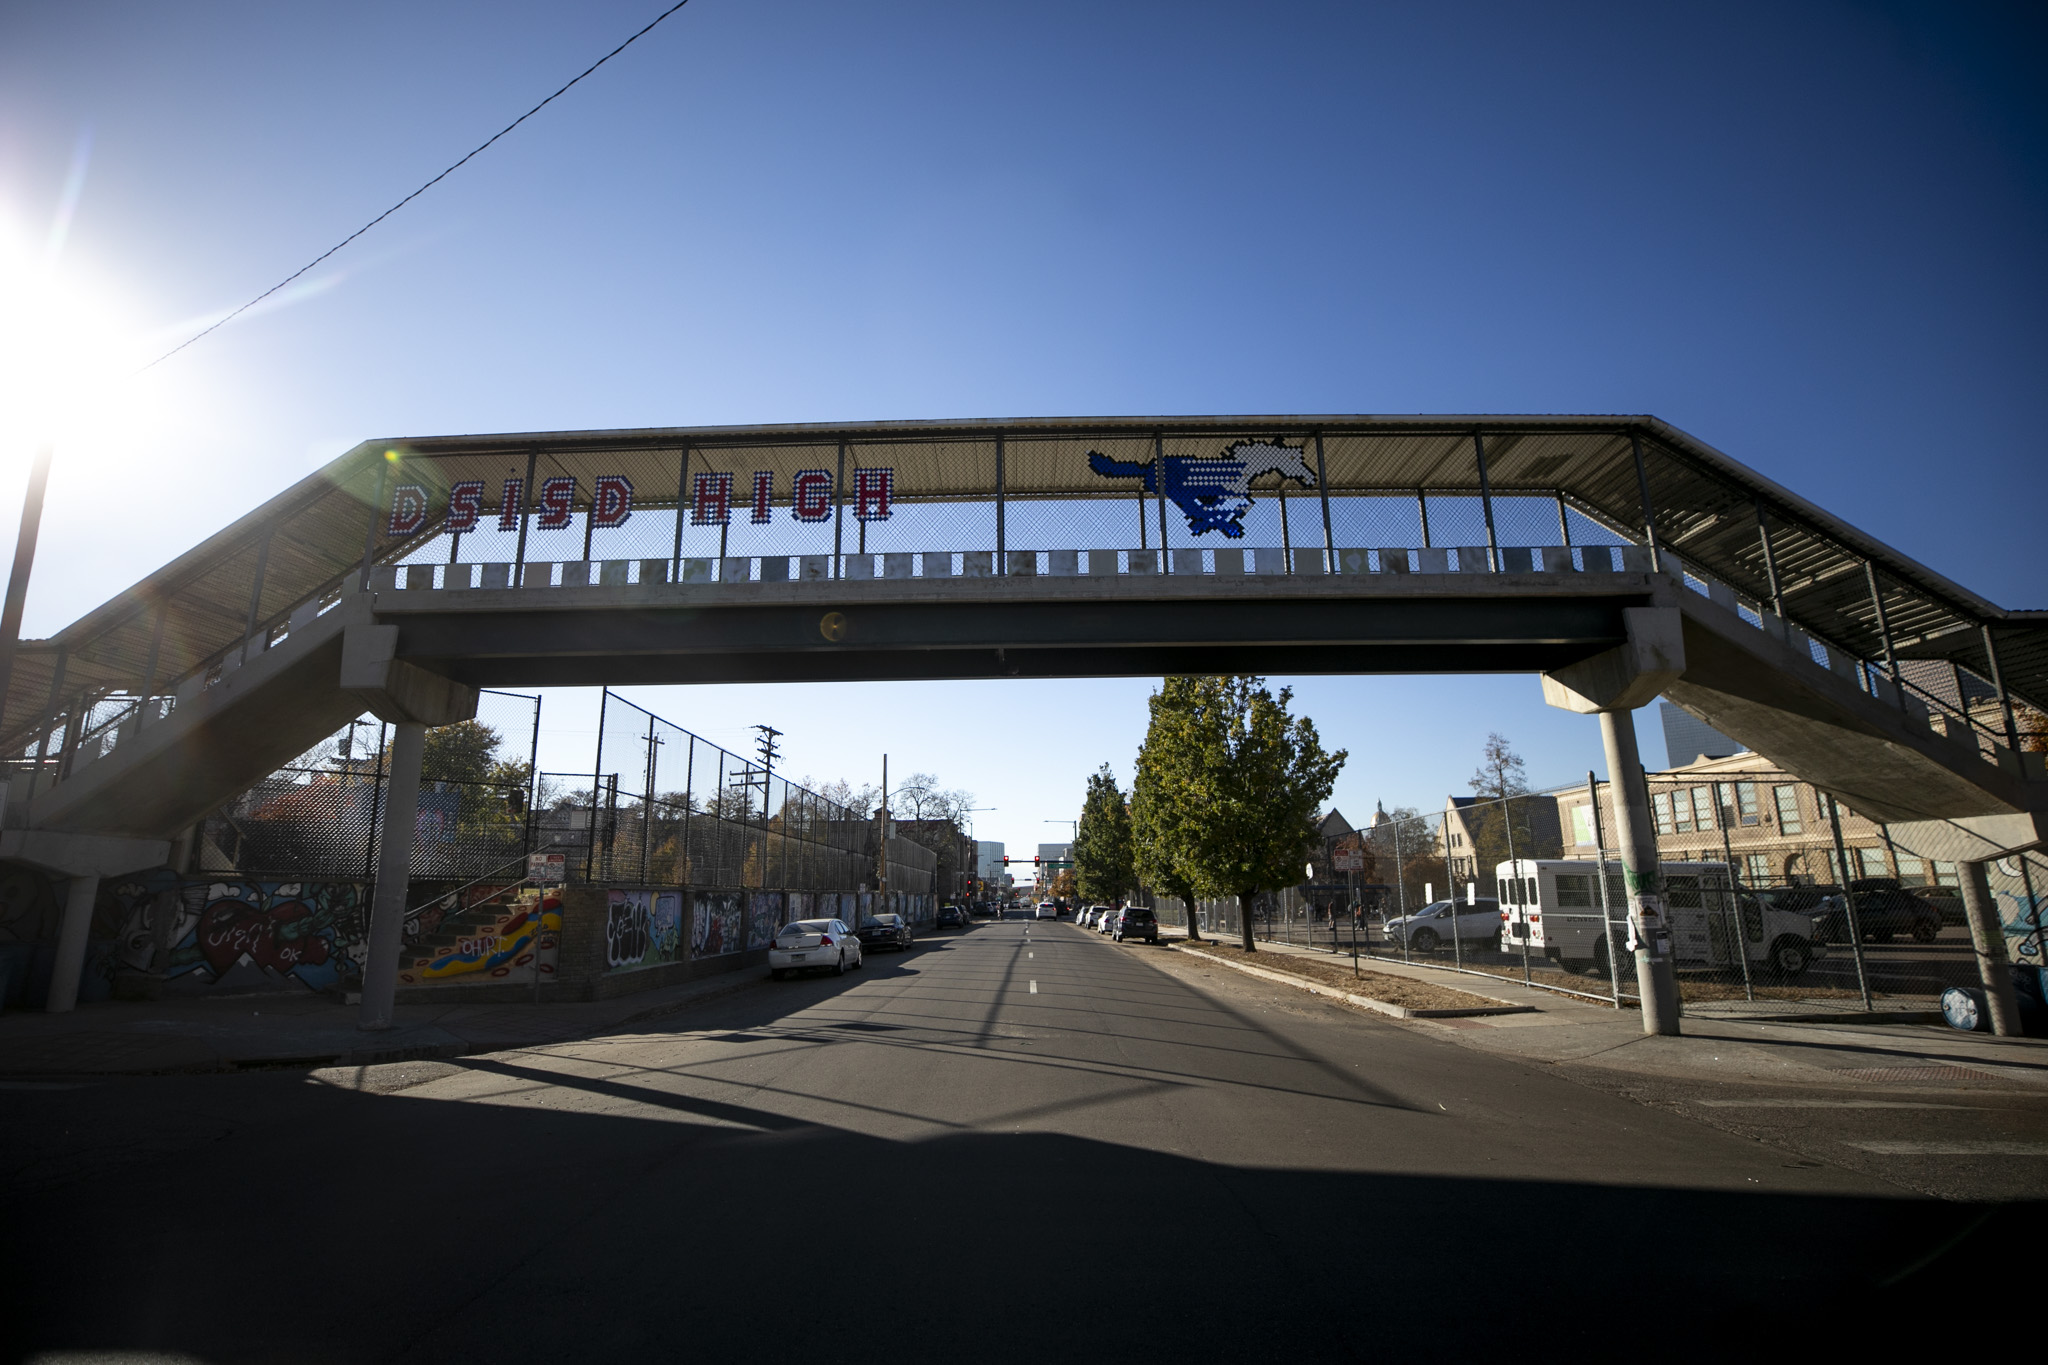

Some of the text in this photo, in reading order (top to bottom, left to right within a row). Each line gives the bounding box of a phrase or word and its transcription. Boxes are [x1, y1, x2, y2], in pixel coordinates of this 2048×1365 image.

[388, 467, 895, 537] DSISD HIGH
[279, 946, 303, 962] OK
